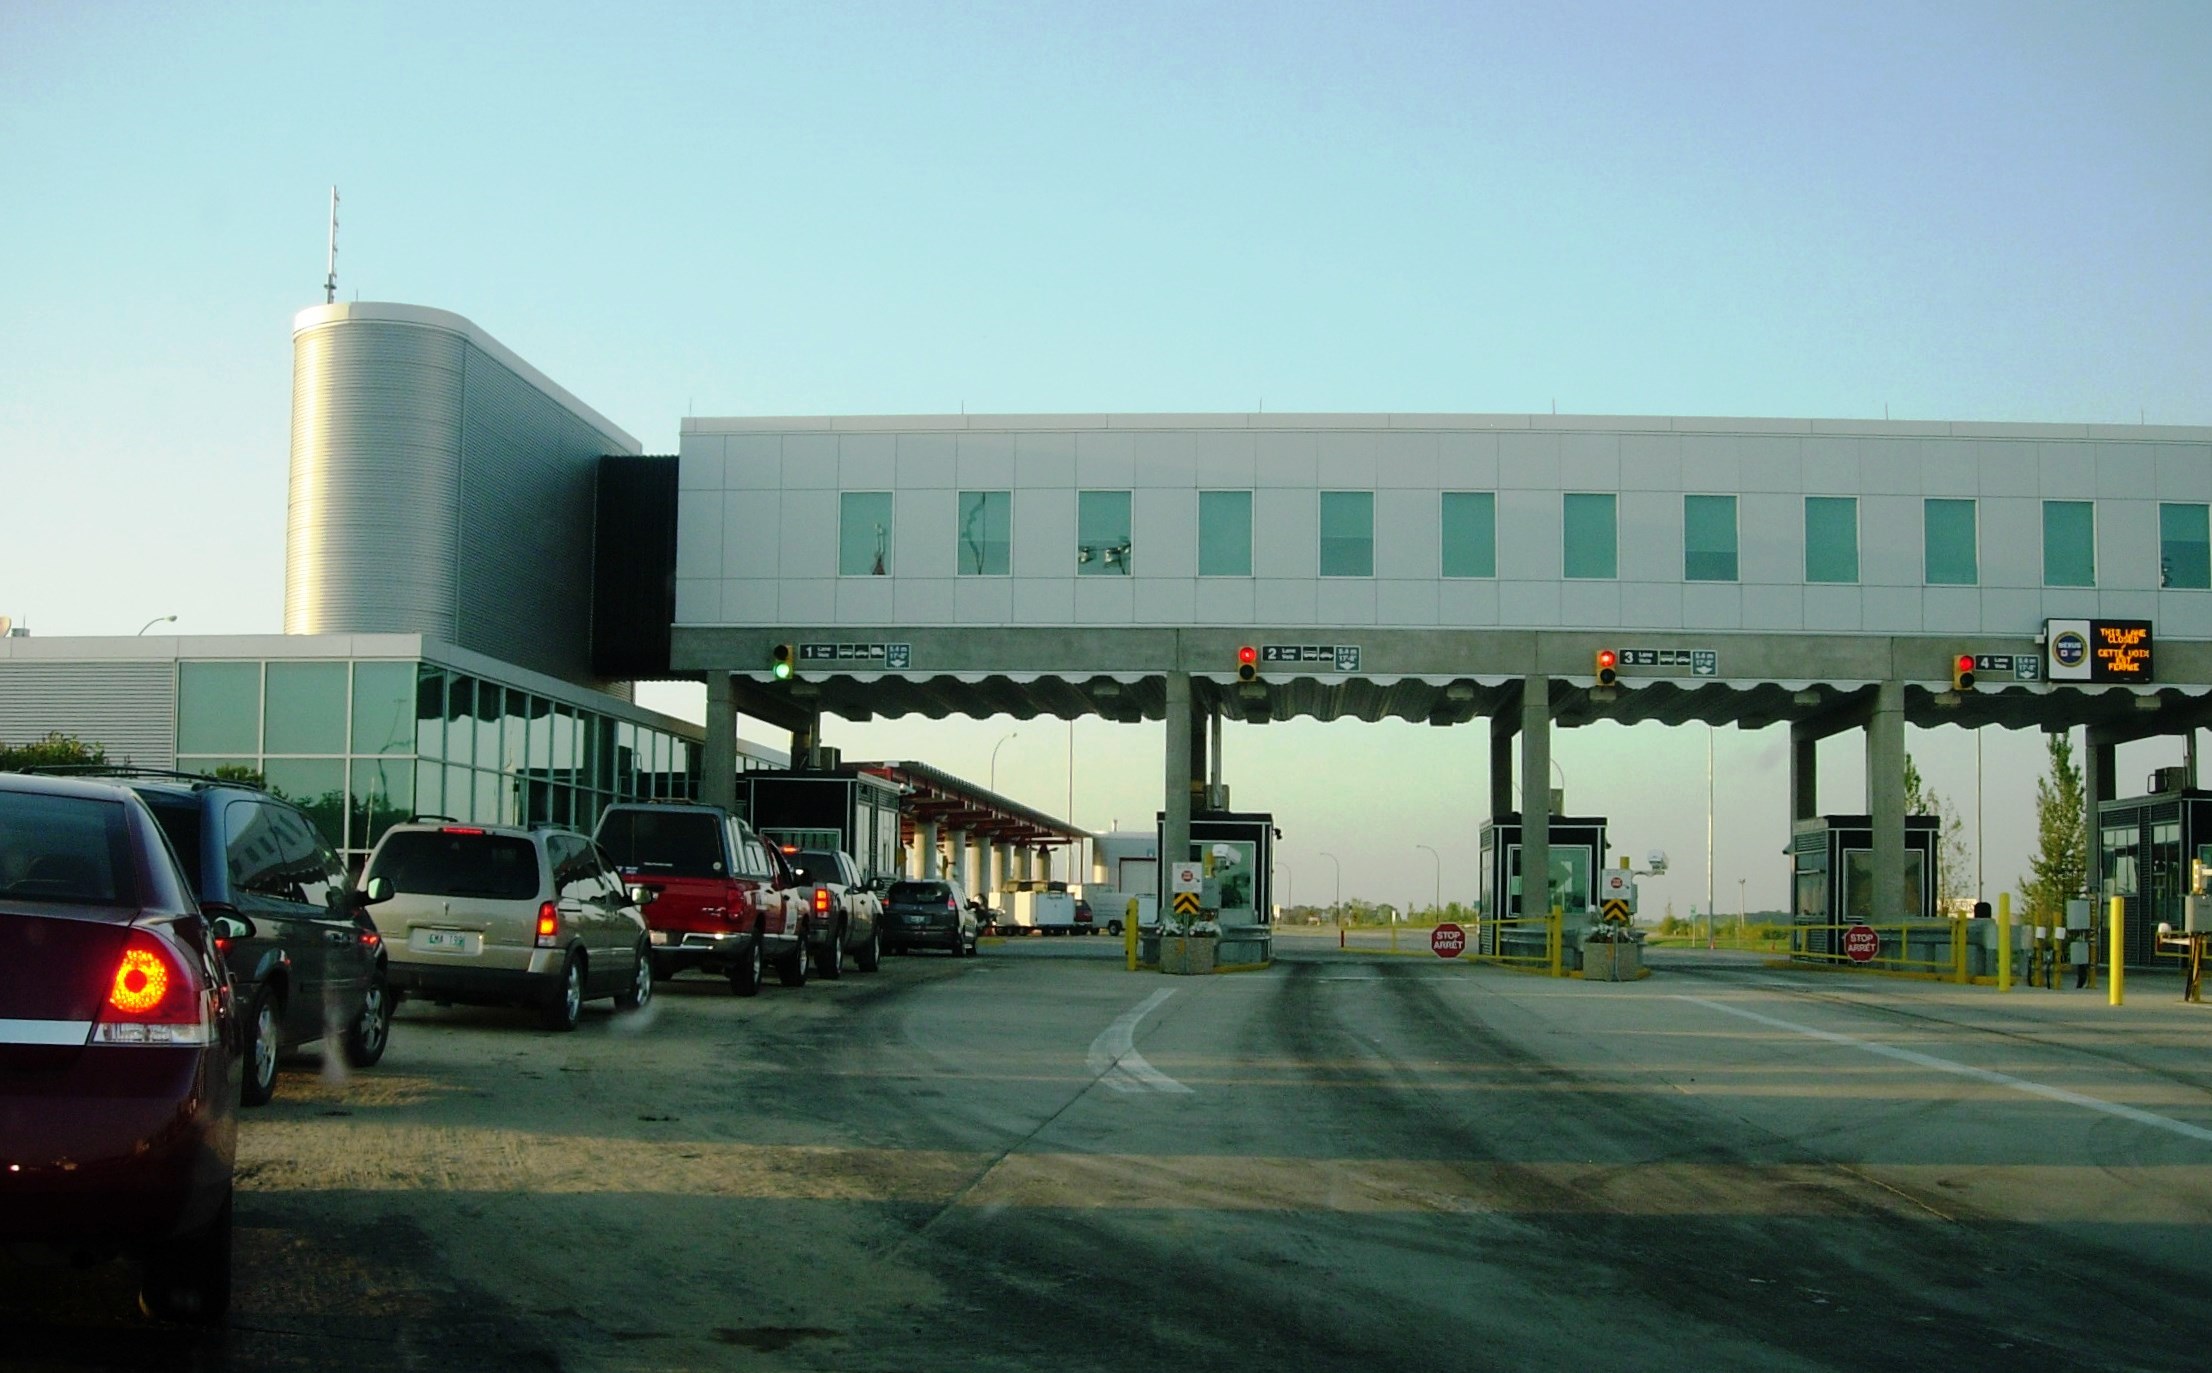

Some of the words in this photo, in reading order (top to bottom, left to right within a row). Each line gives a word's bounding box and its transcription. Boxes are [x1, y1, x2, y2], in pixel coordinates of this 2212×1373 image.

[2100, 628, 2121, 637] THIS
[2125, 629, 2147, 637] LANE
[2108, 635, 2139, 644] CLOSED
[806, 646, 812, 658] 1
[1268, 648, 1277, 660] 2
[2098, 649, 2123, 658] CETTE
[1624, 651, 1634, 664] 3
[1980, 657, 1989, 669] 4
[1436, 931, 1461, 940] STOP
[1850, 933, 1873, 942] STOP
